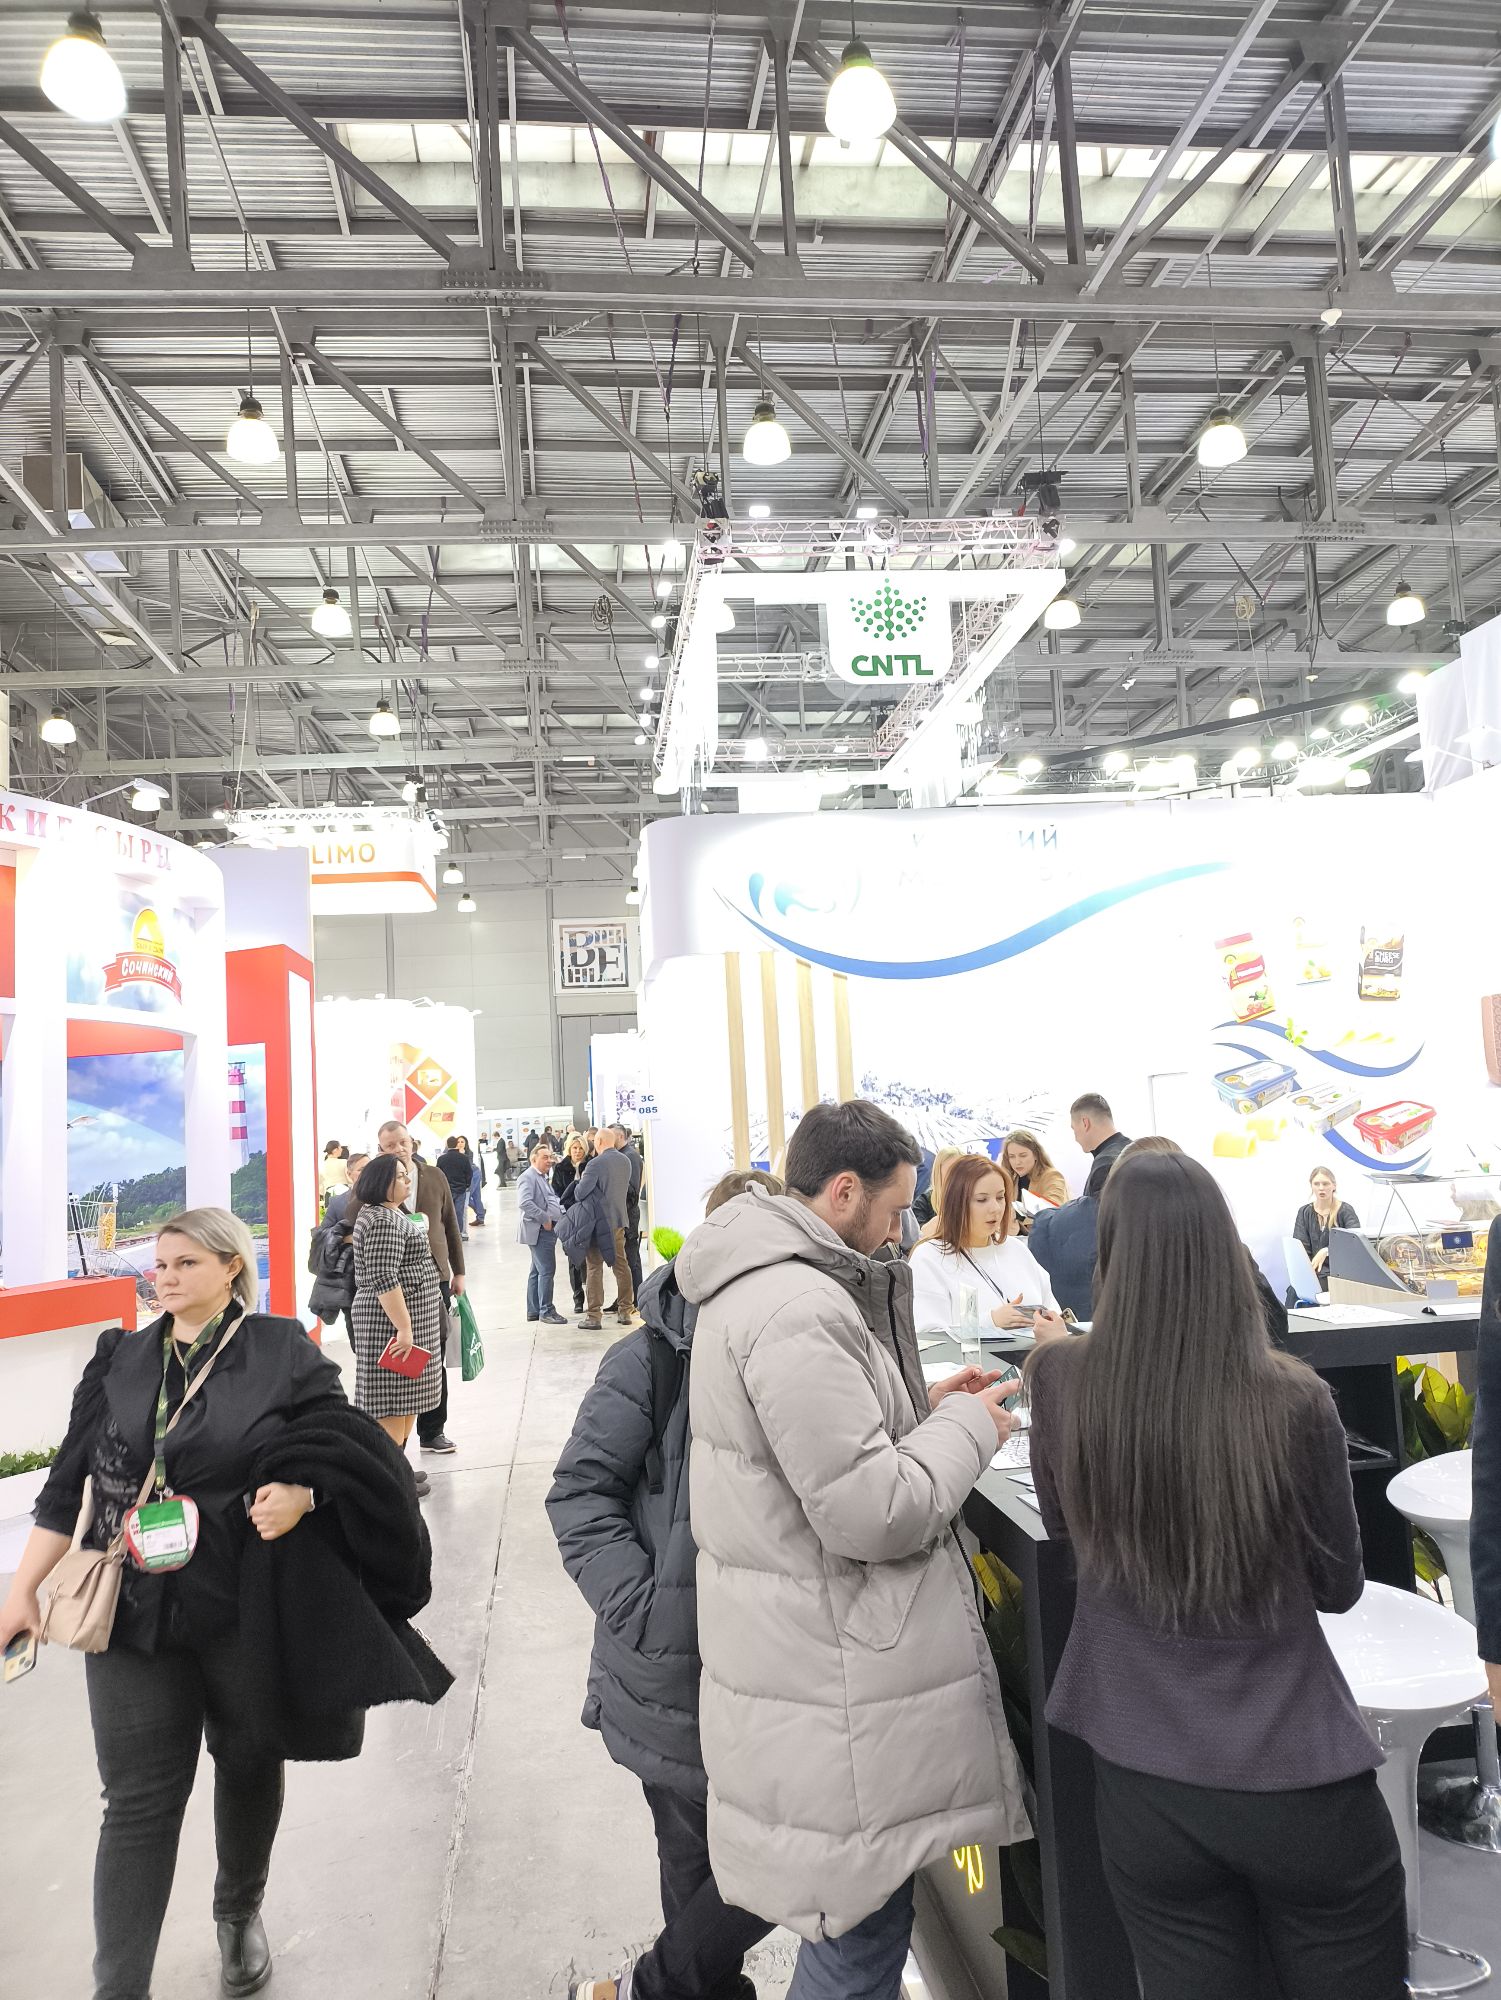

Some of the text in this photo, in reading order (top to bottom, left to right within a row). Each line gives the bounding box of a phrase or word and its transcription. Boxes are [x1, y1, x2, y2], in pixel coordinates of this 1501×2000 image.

[851, 654, 934, 677] CNTL
[312, 842, 377, 865] LIMO
[1374, 950, 1401, 959] CHEESE
[638, 1106, 658, 1114] 085
